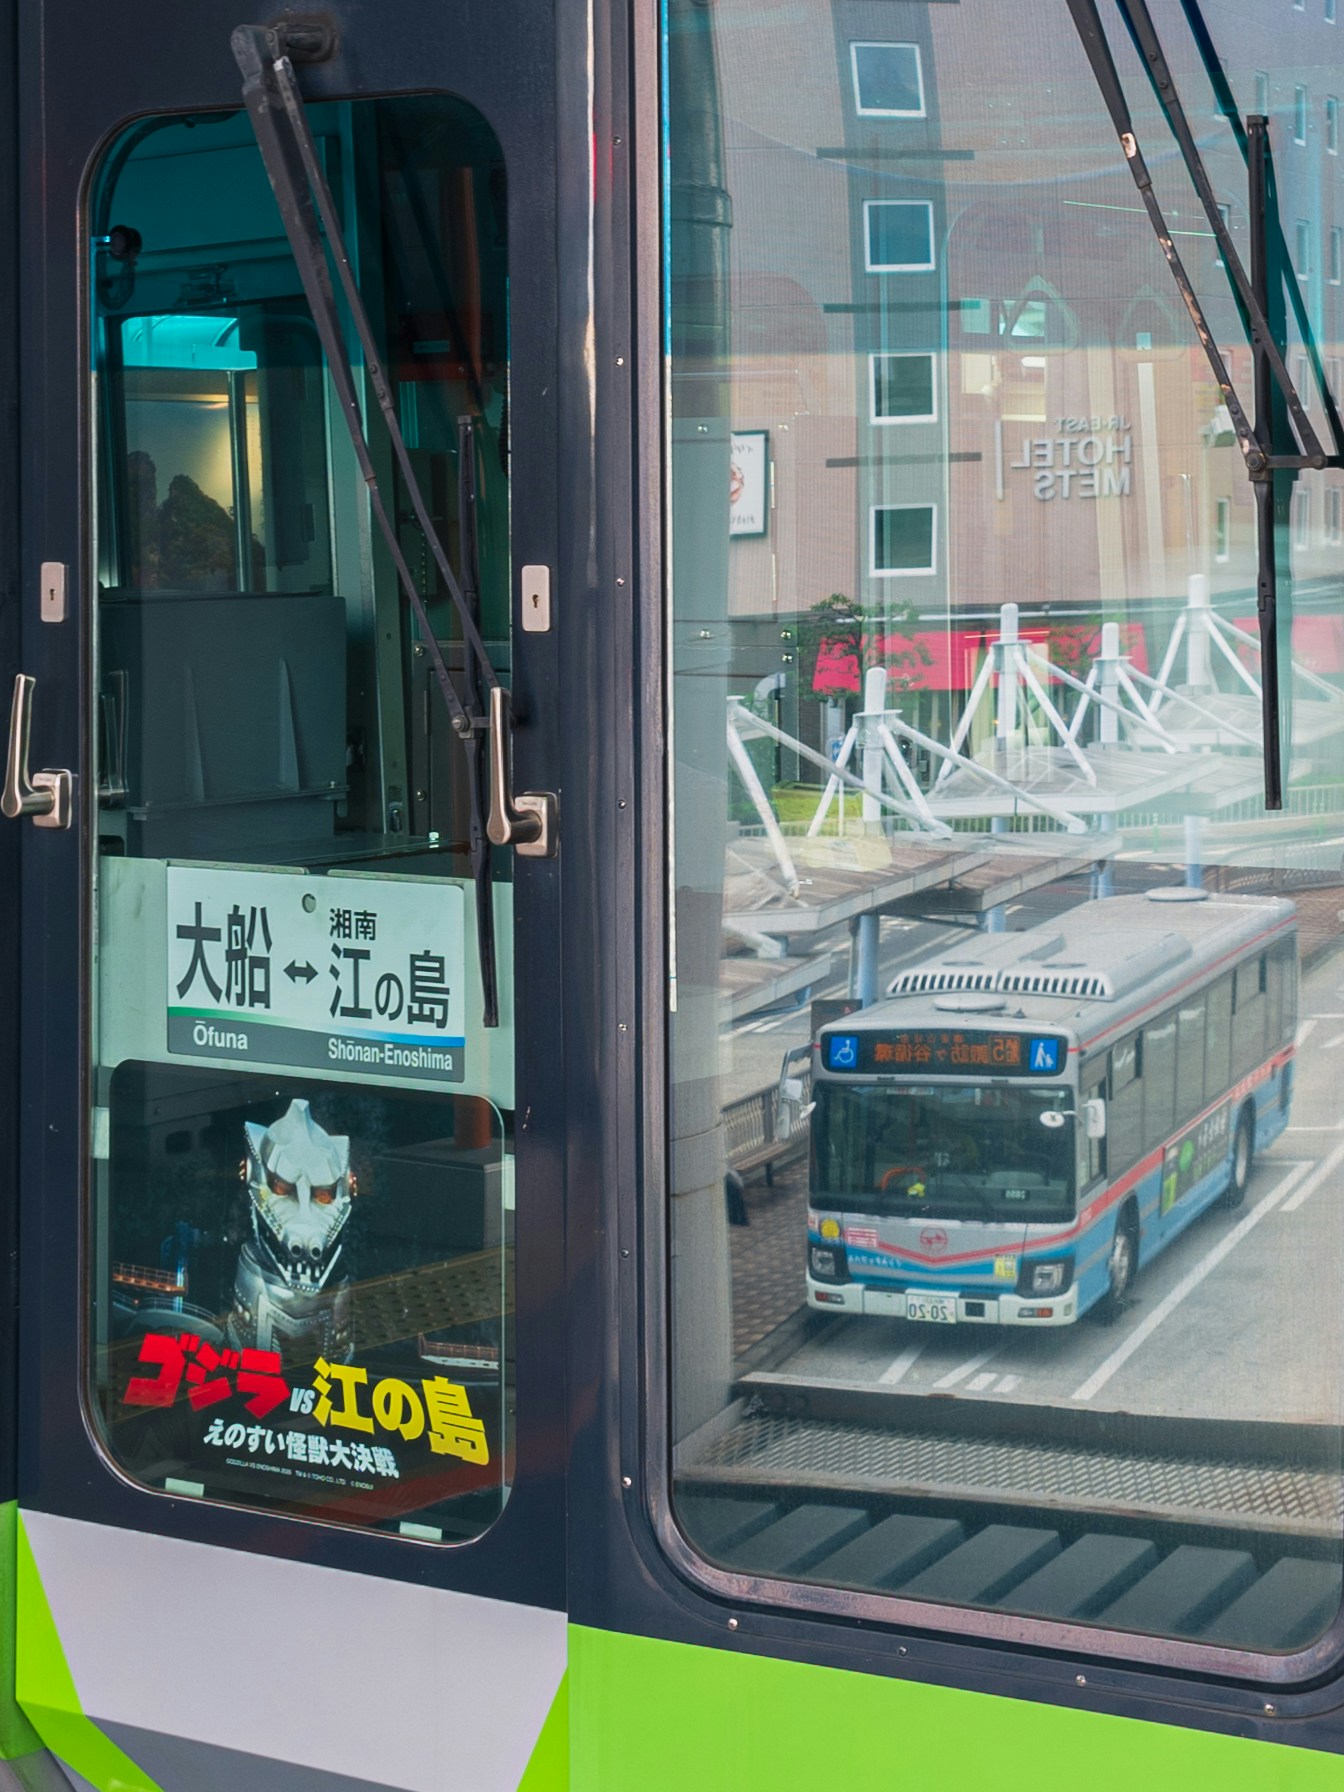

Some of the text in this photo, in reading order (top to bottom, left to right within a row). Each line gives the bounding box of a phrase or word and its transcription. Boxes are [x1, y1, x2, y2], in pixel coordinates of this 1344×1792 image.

[329, 907, 378, 941] 湘南
[176, 901, 451, 1029] 大船 江の島
[193, 1020, 453, 1071] Ōfuna Shōnan-Enoshima
[122, 1333, 291, 1419] ゴジラ
[312, 1355, 490, 1466] 江の島
[203, 1418, 400, 1479] えのすい怪獣大決戦
